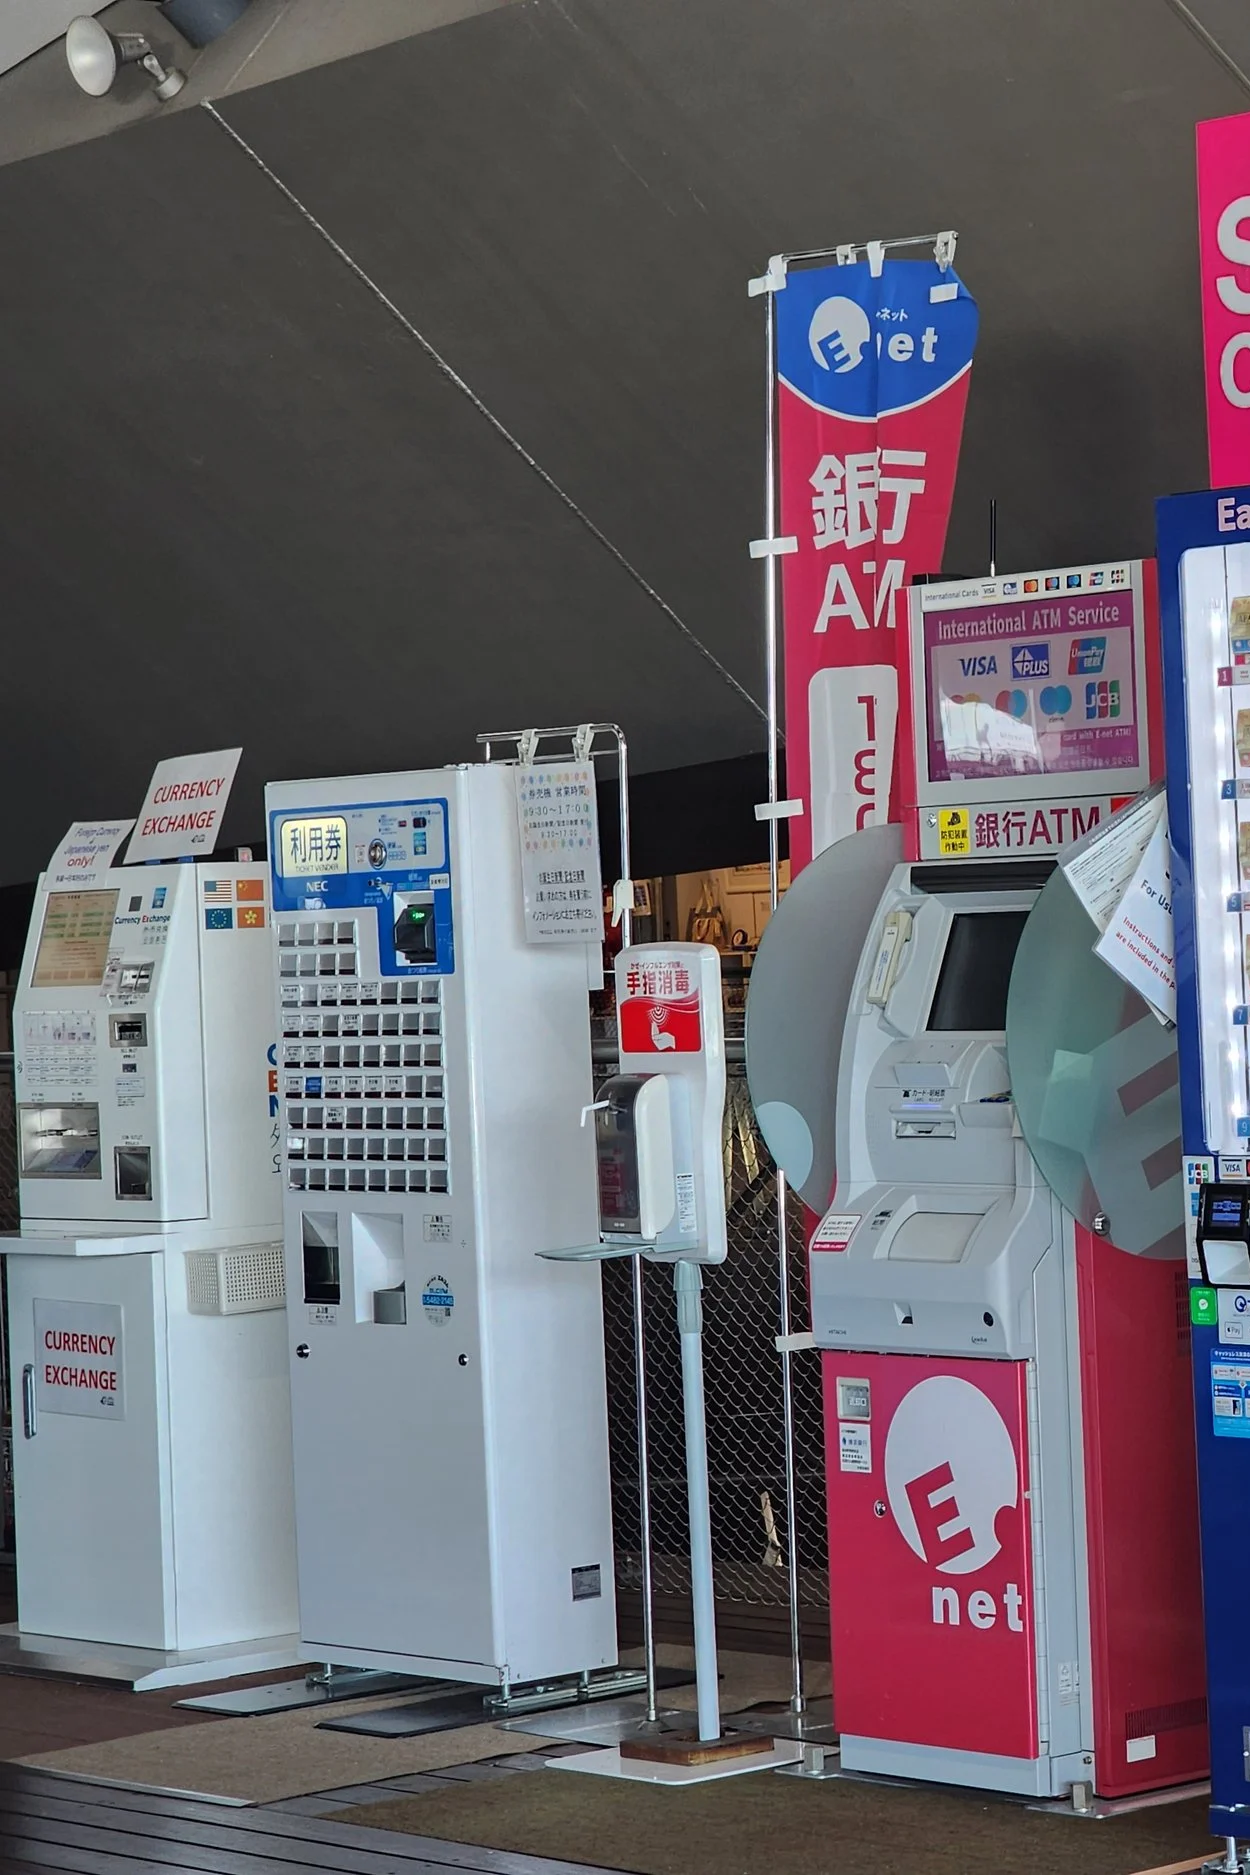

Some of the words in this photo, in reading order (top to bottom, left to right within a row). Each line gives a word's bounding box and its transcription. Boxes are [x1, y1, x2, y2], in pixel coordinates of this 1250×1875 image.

[876, 308, 908, 321] ネット
[809, 446, 926, 550] 銀行
[925, 591, 961, 602] International
[961, 589, 979, 598] Cards
[939, 613, 1026, 640] International
[1032, 608, 1061, 630] ATM
[1069, 602, 1119, 626] Service
[1072, 646, 1104, 658] UnionPay
[959, 656, 997, 676] VISA
[1023, 660, 1048, 675] PLUS
[1086, 693, 1120, 708] JCB
[154, 777, 225, 804] CURRENCY
[1226, 786, 1231, 794] 3
[141, 810, 216, 836] EXCHANGE
[975, 806, 1100, 848] 銀行ATM
[941, 830, 967, 840] 防犯装置
[290, 823, 341, 863] 利用券
[945, 842, 964, 851] 作動中
[67, 856, 95, 868] only!
[306, 880, 328, 892] NEC
[1141, 879, 1156, 900] For
[1231, 897, 1237, 906] 5
[114, 916, 141, 925] Currency
[142, 914, 171, 923] Exchange
[1123, 916, 1160, 954] Instructions
[1160, 951, 1172, 965] and
[1116, 930, 1127, 943] are
[1127, 940, 1152, 967] included
[1159, 969, 1170, 982] the
[626, 970, 690, 995] 手指消毒
[1238, 1010, 1242, 1019] 7
[1242, 1122, 1247, 1132] 9
[1188, 1170, 1207, 1178] JCB
[1225, 1164, 1240, 1172] VISA
[44, 1331, 116, 1356] CURRENCY
[45, 1365, 117, 1391] EXCHANGE
[932, 1583, 1024, 1632] net
